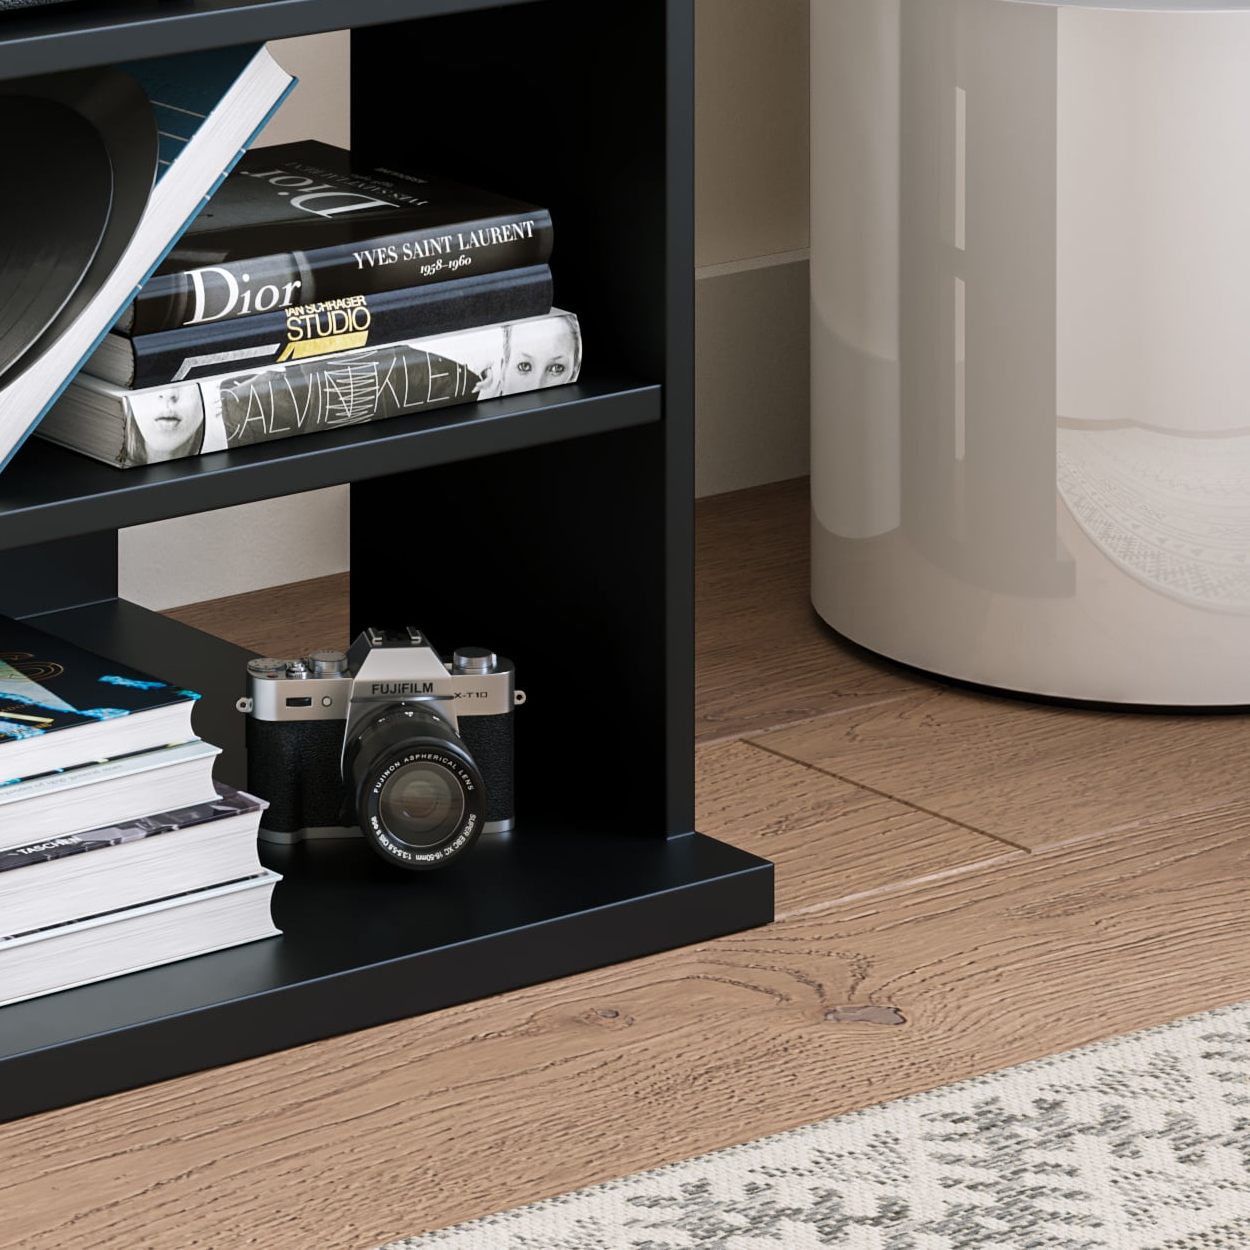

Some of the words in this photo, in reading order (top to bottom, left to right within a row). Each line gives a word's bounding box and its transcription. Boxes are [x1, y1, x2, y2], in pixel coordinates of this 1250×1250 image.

[352, 245, 398, 270] YVES
[403, 235, 453, 261] SAINT
[457, 220, 535, 251] LAURENT
[183, 267, 302, 326] Dior
[304, 294, 368, 314] SCHRAGER
[286, 306, 371, 342] STUDIO
[371, 681, 434, 695] FUJIFILM
[454, 691, 488, 700] X-T10
[373, 761, 401, 794] FUJINON
[403, 753, 457, 769] ASPHERICAL
[458, 770, 475, 791] LENS
[463, 813, 477, 837] SUPER
[16, 835, 83, 855] TASCHEN
[443, 846, 455, 856] XC
